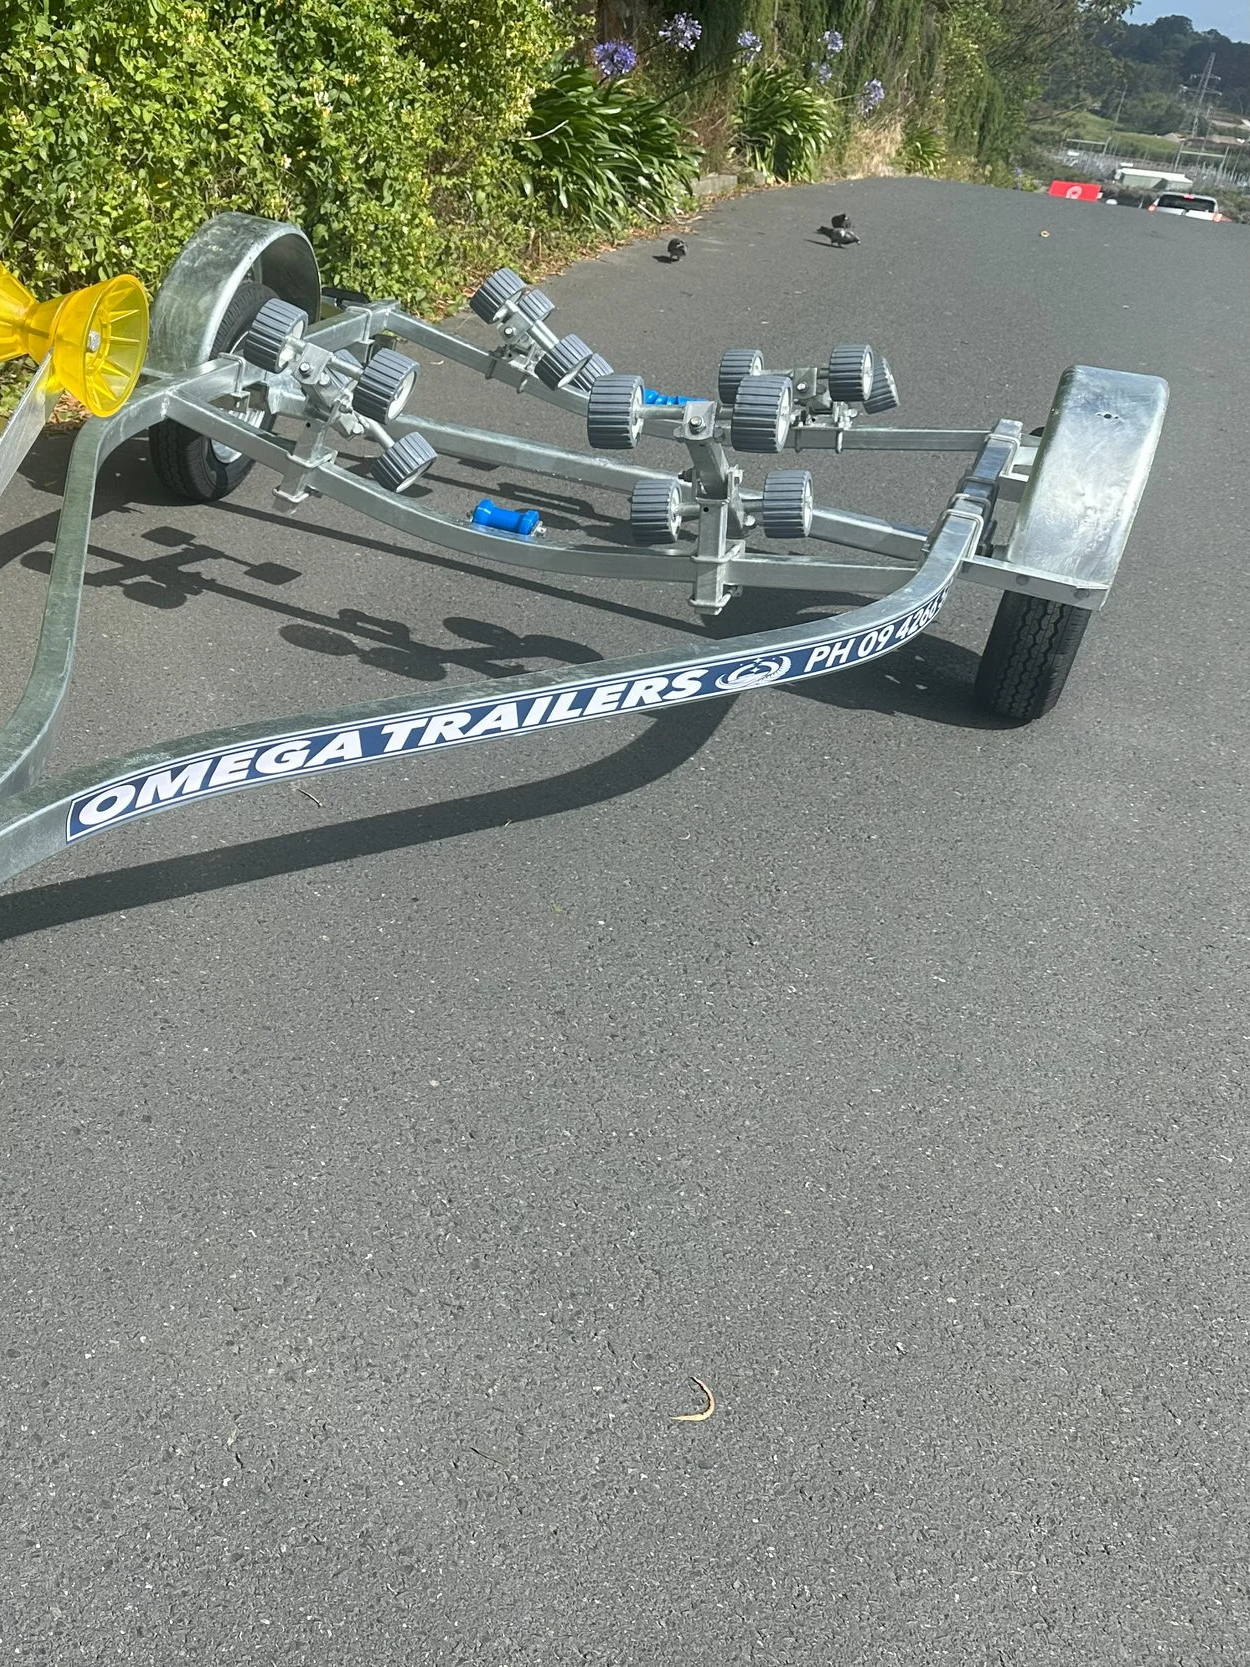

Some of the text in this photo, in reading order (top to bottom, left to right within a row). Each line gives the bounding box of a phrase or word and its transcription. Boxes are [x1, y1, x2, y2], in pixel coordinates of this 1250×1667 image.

[78, 730, 363, 826] OMEGA
[380, 668, 710, 753] TRAILERS
[803, 638, 857, 673] PH
[857, 625, 895, 658] 09
